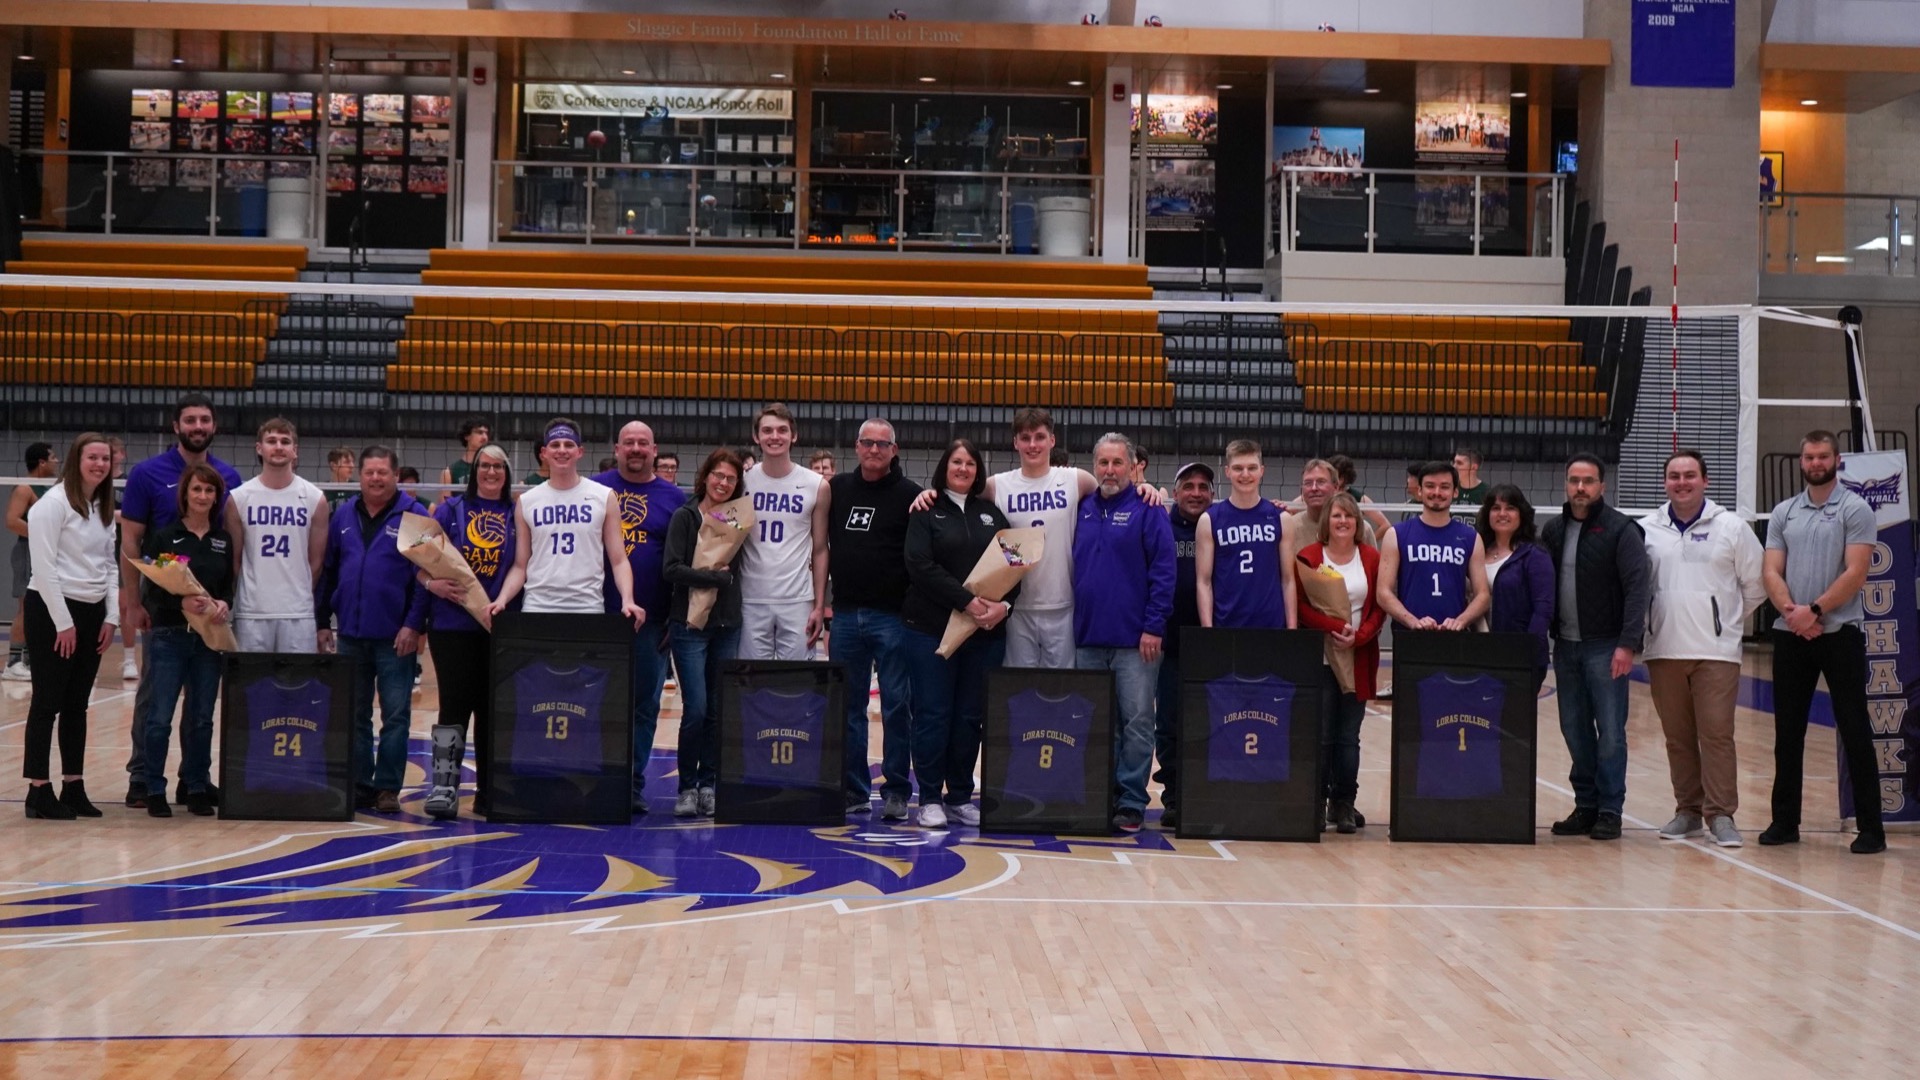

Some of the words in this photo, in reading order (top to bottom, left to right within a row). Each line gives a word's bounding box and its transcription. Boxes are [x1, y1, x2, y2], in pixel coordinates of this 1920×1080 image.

[1648, 14, 1675, 26] 2008
[1672, 4, 1695, 13] NCAA
[627, 19, 684, 38] Slaggie
[691, 21, 744, 40] Family
[753, 22, 848, 39] Foundation
[855, 25, 890, 41] Hall
[896, 26, 913, 41] of
[920, 27, 963, 42] Fame
[563, 93, 646, 109] Conference
[664, 96, 705, 109] NCAA
[710, 97, 752, 111] Honor
[757, 98, 783, 112] Roll
[745, 491, 804, 514] ORAS
[1007, 489, 1067, 514] LORAS
[1865, 493, 1898, 503] EYBALL
[247, 505, 308, 527] LORAS
[533, 504, 592, 528] LORAS
[759, 520, 784, 543] 10
[1217, 524, 1276, 547] LORAS
[261, 534, 290, 558] 24
[463, 545, 504, 563] GAM
[550, 532, 575, 555] 13
[1407, 544, 1466, 566] LORAS
[1240, 550, 1253, 573] 2
[1431, 572, 1442, 596] 1
[1860, 541, 1908, 813] DUHAWKS
[532, 702, 556, 713] LORAS
[557, 702, 587, 717] COLLEGE
[1224, 710, 1247, 724] LORAS
[1247, 710, 1278, 726] COLLEGE
[1436, 714, 1458, 728] LORAS
[1459, 713, 1490, 729] COLLEGE
[261, 717, 286, 730] LORAS
[286, 717, 318, 732] COLLEGE
[545, 715, 569, 740] 13
[757, 728, 779, 740] LORAS
[780, 728, 810, 742] COLLEGE
[273, 732, 301, 757] 24
[1022, 729, 1046, 742] LORAS
[1046, 730, 1076, 747] COLLEGE
[1245, 733, 1258, 754] 2
[1458, 727, 1467, 751] 1
[771, 741, 793, 764] 10
[1039, 744, 1053, 769] 8
